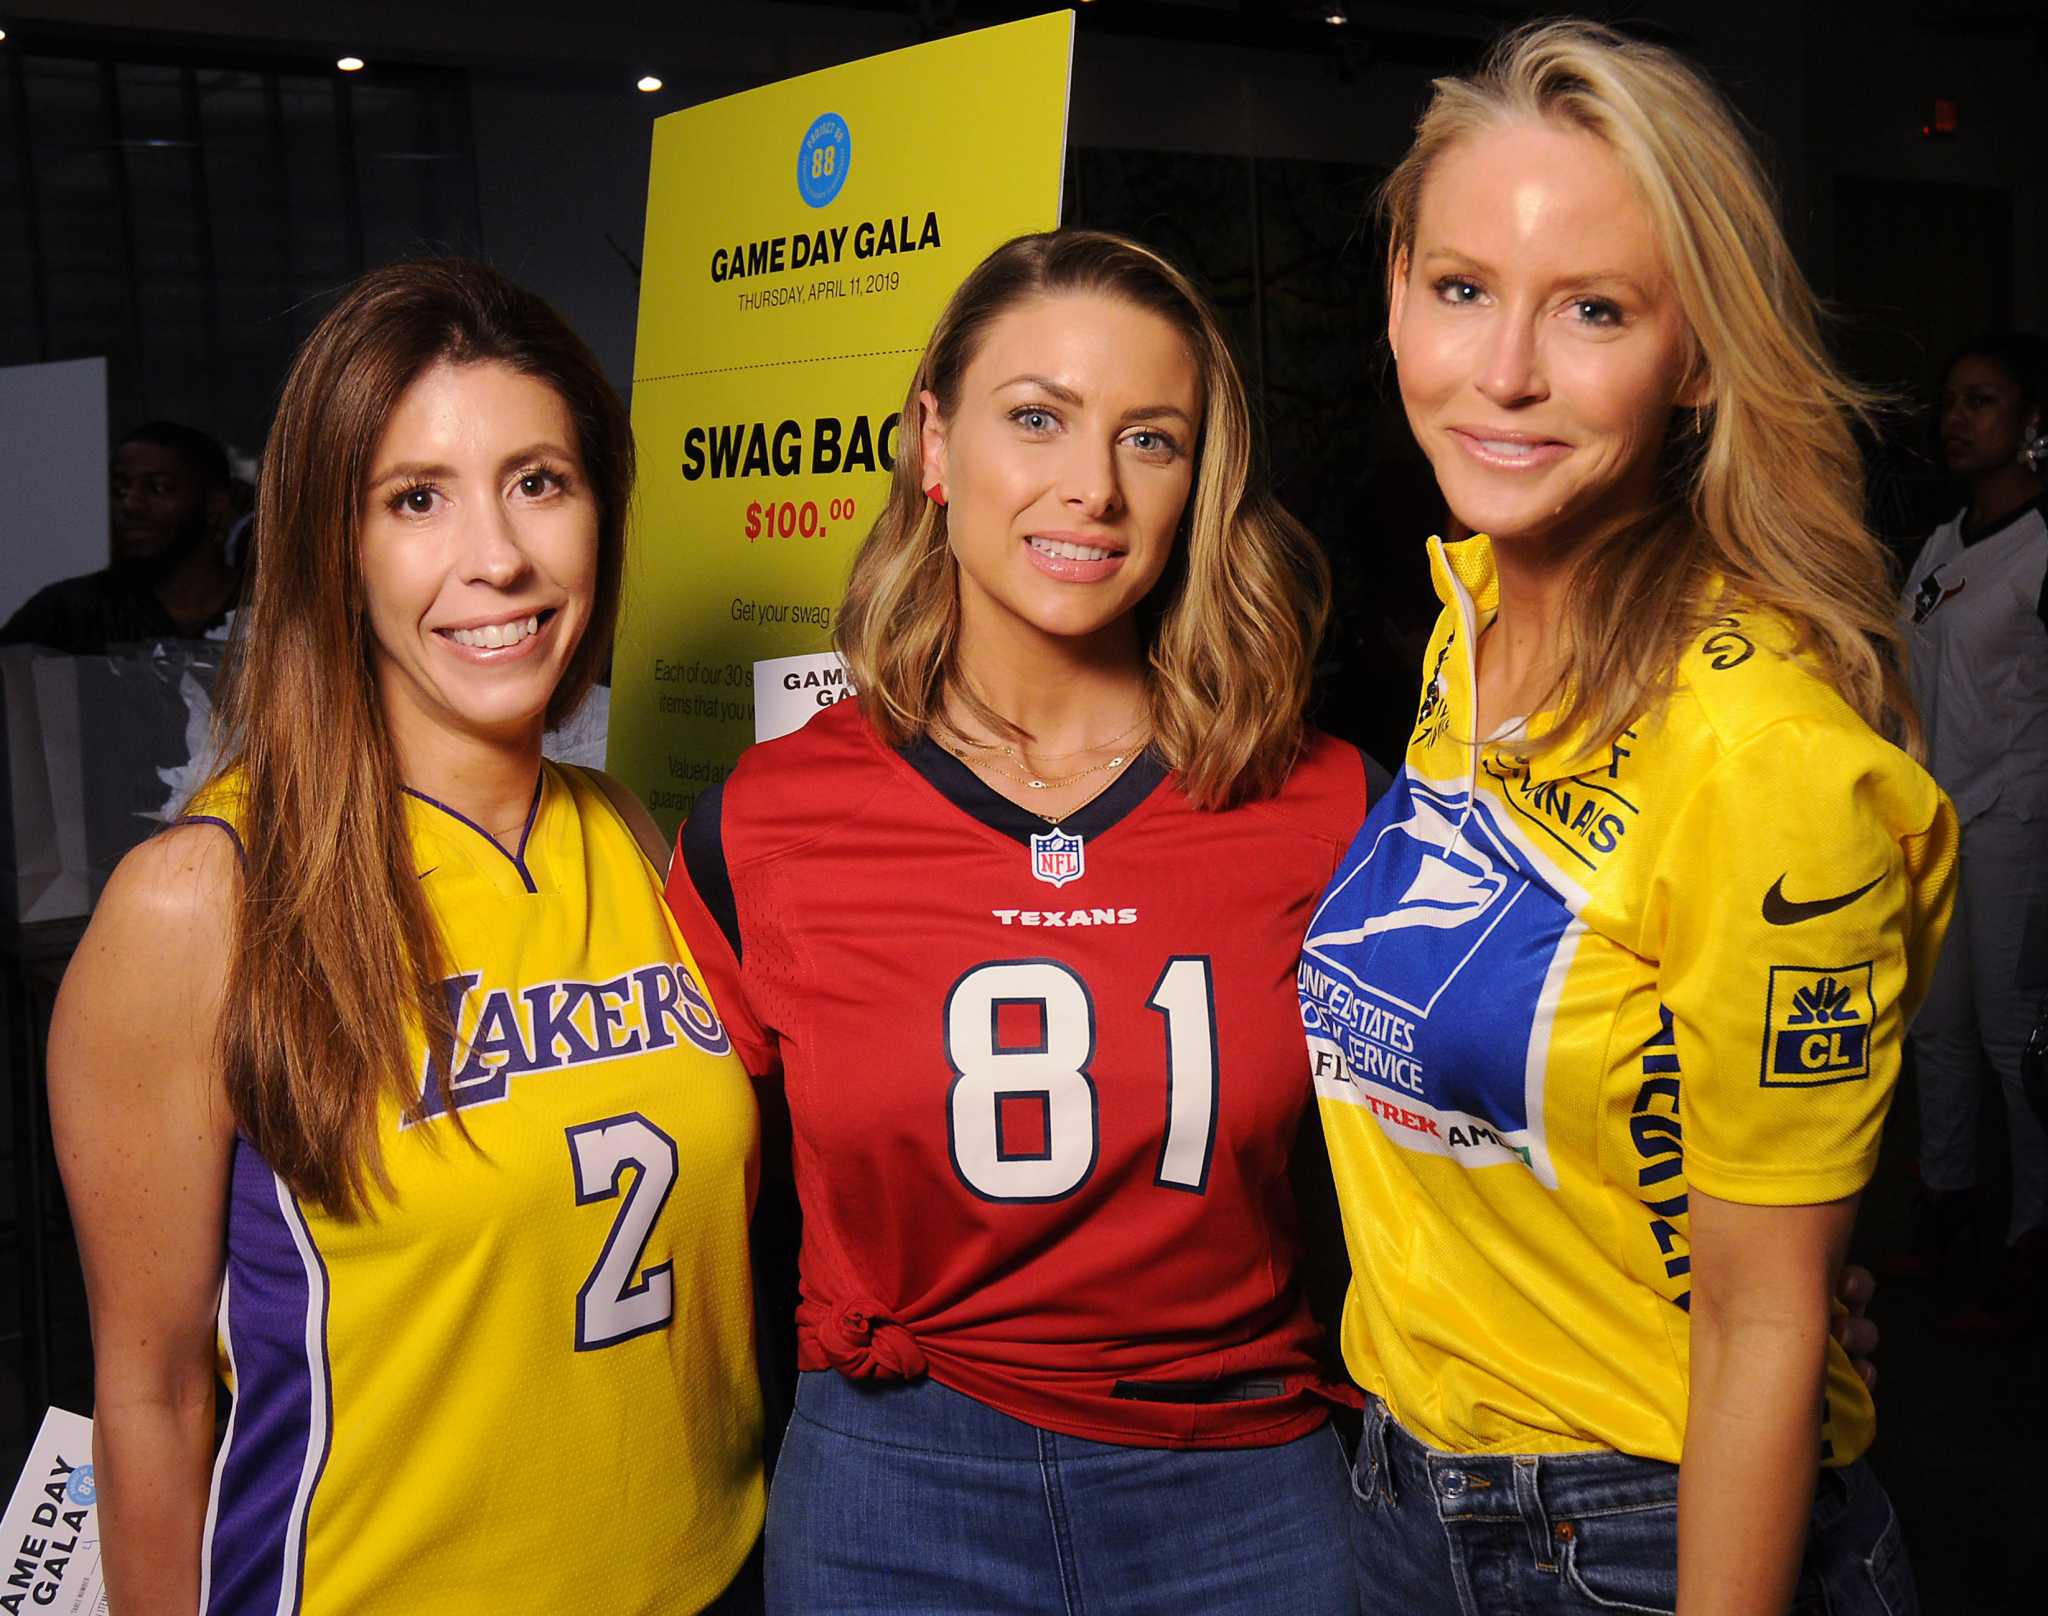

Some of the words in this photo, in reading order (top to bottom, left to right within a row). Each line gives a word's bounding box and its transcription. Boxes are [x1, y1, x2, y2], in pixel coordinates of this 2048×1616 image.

[812, 144, 836, 178] 88
[711, 237, 786, 283] GAME
[790, 225, 849, 269] DAY
[854, 211, 942, 260] GALA
[737, 286, 806, 313] THURSDAY,
[808, 279, 847, 300] APRIL
[849, 276, 865, 297] 11,
[865, 271, 900, 293] 2019
[681, 419, 802, 482] SWAG
[731, 598, 755, 622] Get
[757, 602, 790, 626] your
[791, 605, 831, 630] swag
[655, 659, 685, 683] Each
[687, 661, 700, 684] of
[701, 667, 722, 686] our
[725, 664, 743, 687] 30
[783, 668, 843, 690] GAM
[659, 692, 692, 715] items
[694, 695, 719, 719] that
[720, 702, 744, 724] you
[816, 687, 851, 707] GA
[668, 753, 710, 782] Valued
[649, 790, 695, 811] guarant
[1040, 853, 1077, 876] NFL
[992, 908, 1137, 927] TEXANS
[1297, 960, 1353, 1021] UNITED
[1350, 998, 1416, 1053] STATES
[398, 961, 733, 1132] LAKERS
[1347, 1034, 1425, 1095] SERVICE
[1798, 1033, 1851, 1071] CL
[943, 954, 1220, 1205] 81
[1364, 1094, 1441, 1139] TREK
[1449, 1125, 1500, 1148] AM
[564, 1111, 679, 1353] 2
[78, 1475, 96, 1496] 88
[0, 1534, 47, 1616] AME
[31, 1455, 76, 1528] DAY
[32, 1510, 88, 1606] GALA
